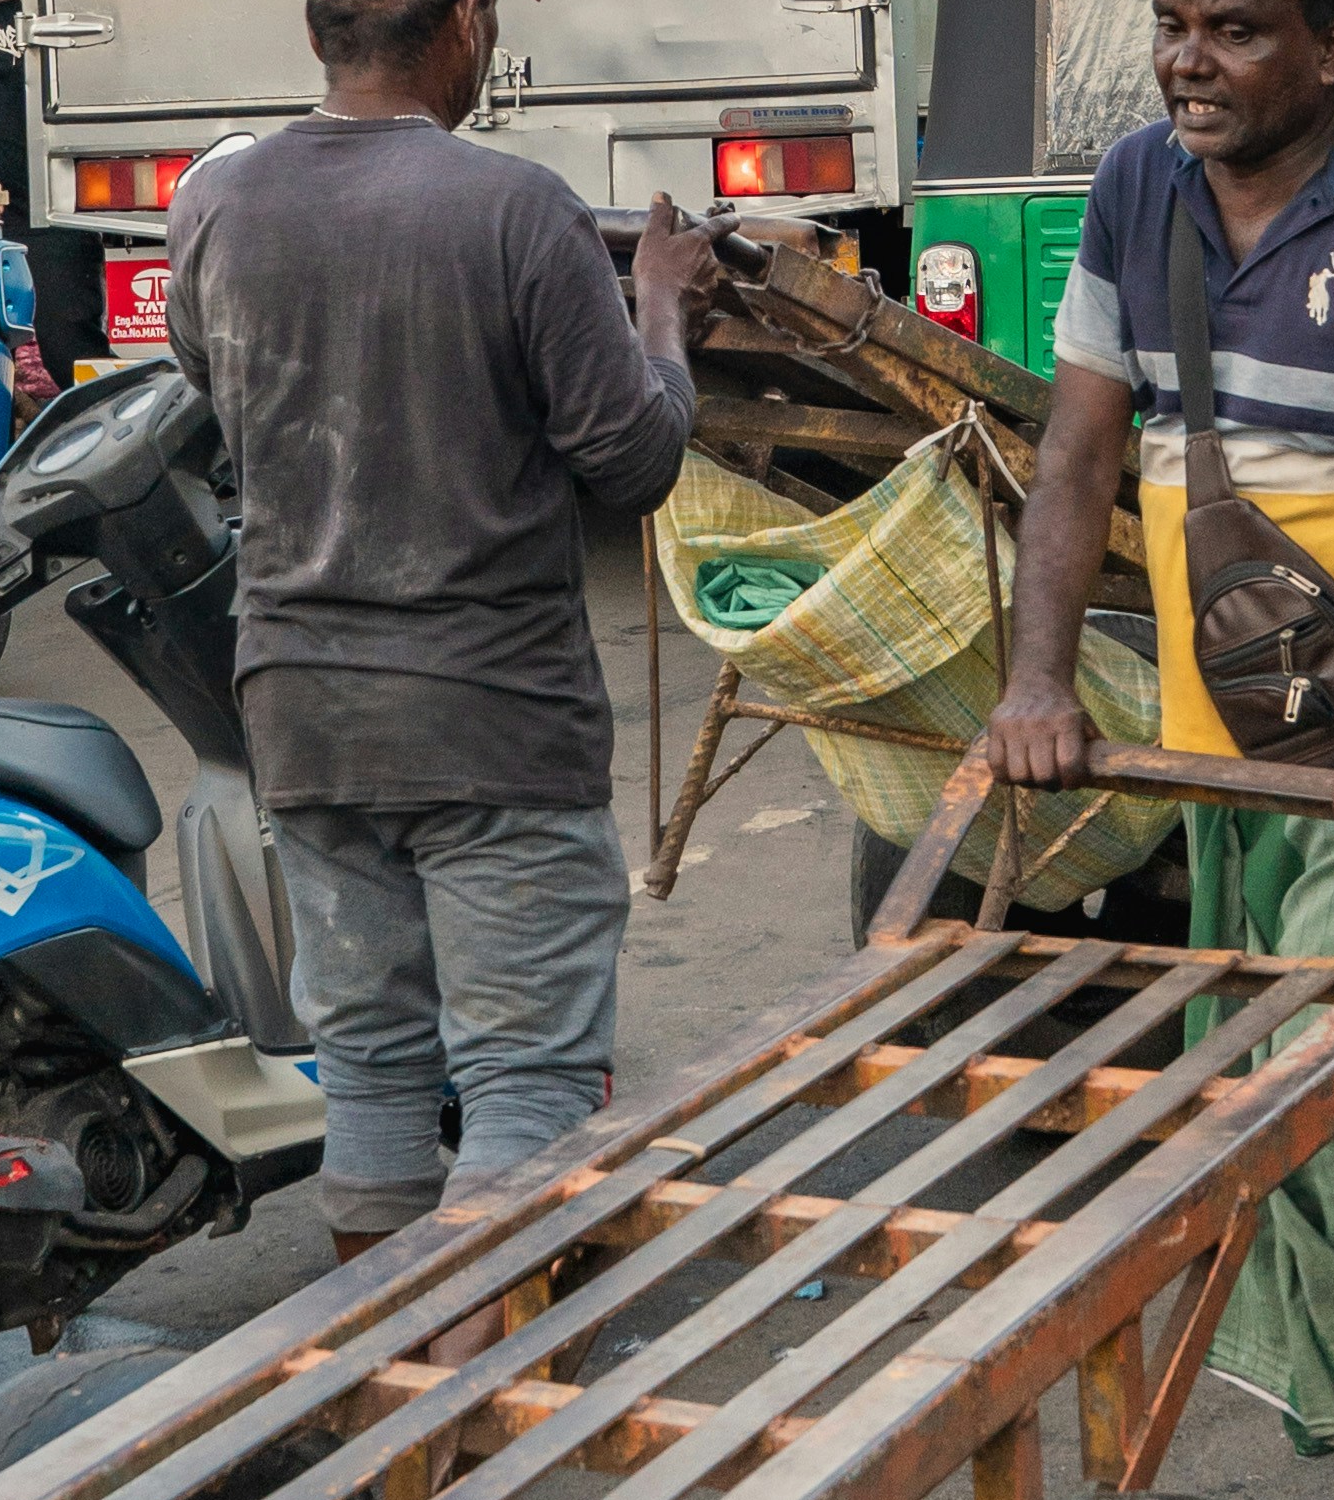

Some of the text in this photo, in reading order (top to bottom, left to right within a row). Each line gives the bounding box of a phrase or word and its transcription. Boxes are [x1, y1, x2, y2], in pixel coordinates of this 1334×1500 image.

[773, 108, 808, 117] Truck
[811, 107, 845, 116] Body
[134, 301, 167, 313] TAT
